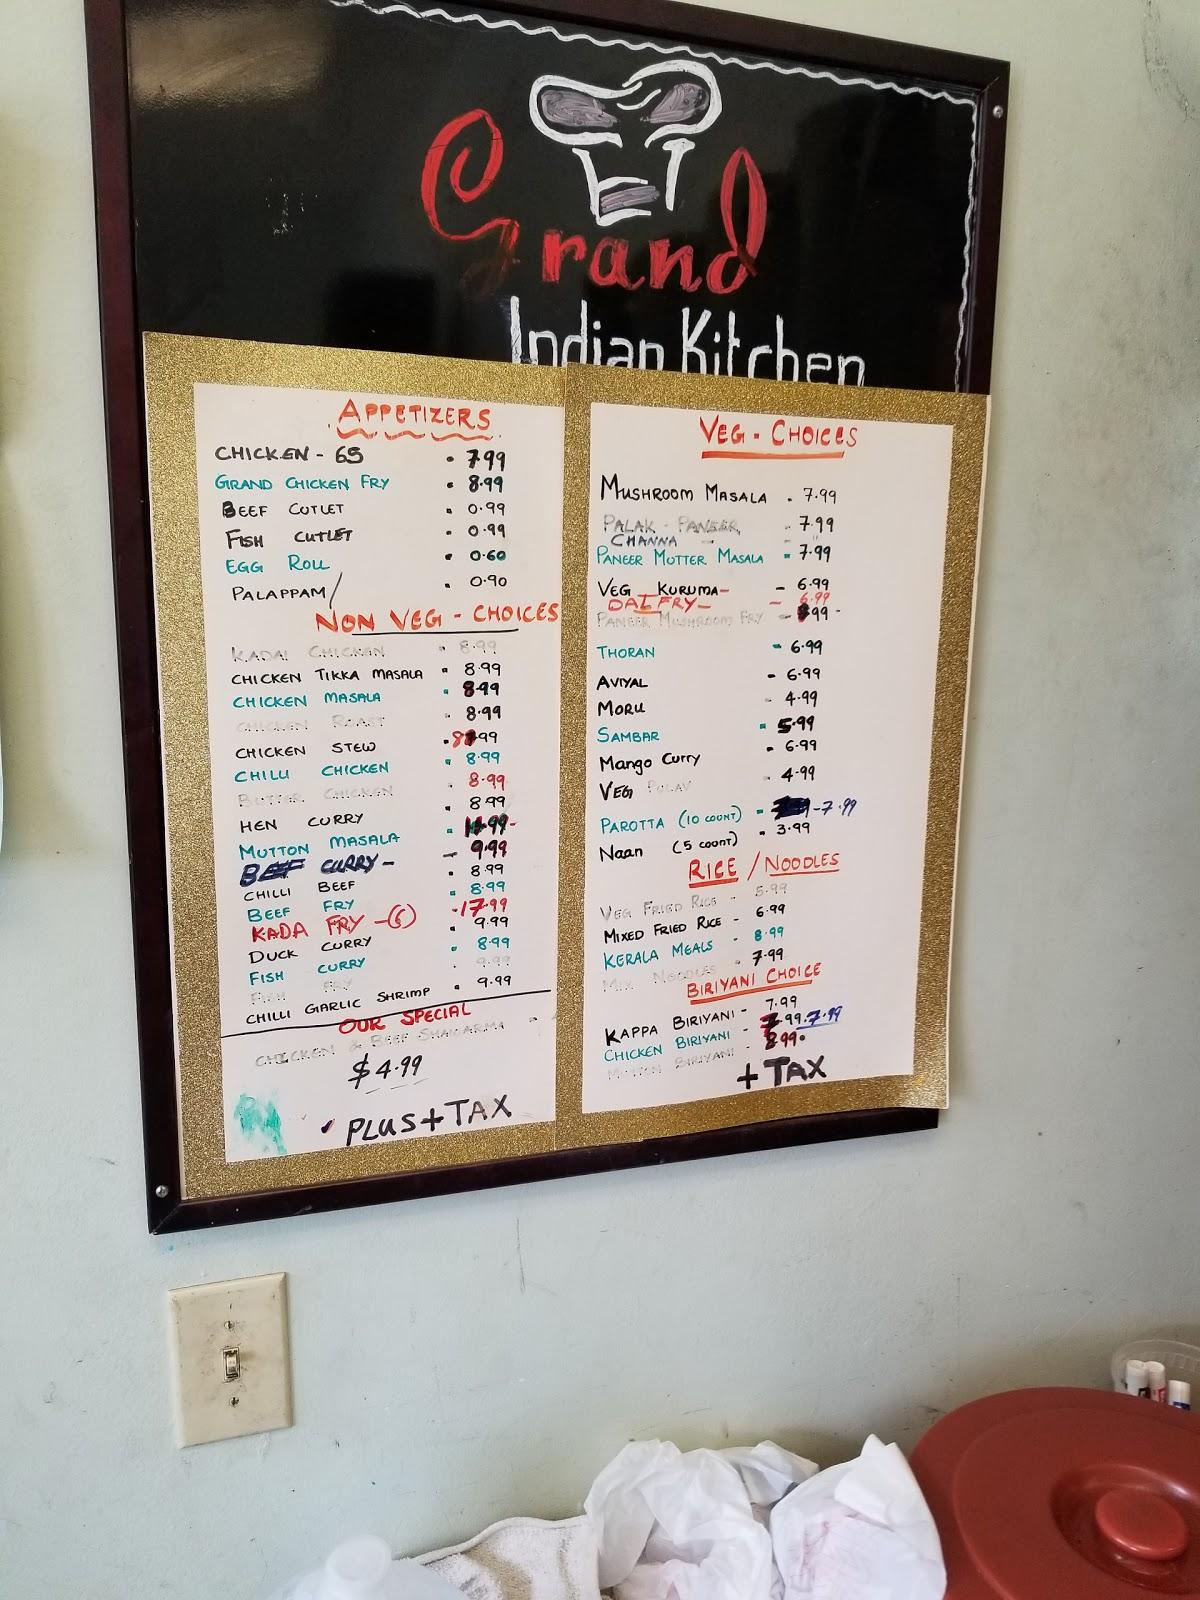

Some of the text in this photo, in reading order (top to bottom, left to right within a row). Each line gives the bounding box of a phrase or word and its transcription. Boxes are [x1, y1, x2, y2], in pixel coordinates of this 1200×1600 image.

[421, 108, 767, 295] Grand
[510, 296, 865, 387] Indian Kitchen
[338, 398, 491, 431] APPETIZERS
[700, 415, 745, 445] VEG
[215, 446, 308, 461] CHICKEN
[335, 446, 364, 463] 65
[215, 474, 504, 493] GRAND CHICKEN FRY 8.99
[601, 473, 837, 504] MUSHROOM MASALA 7.99
[223, 501, 505, 518] BEEF CUTLET 0.99
[225, 523, 506, 549] FISH CUTLET 0.99
[799, 515, 834, 533] 7.99
[226, 549, 506, 574] EGG ROLL 0.60
[596, 545, 643, 566] PANEER
[718, 547, 764, 564] MASALA
[799, 544, 831, 563] 7.99
[469, 574, 507, 587] 0.90
[597, 577, 631, 597] VEG
[797, 578, 829, 592] 6.99
[315, 602, 559, 633] NON VEG CHOICES
[597, 639, 823, 659] THORAN 6.99
[231, 662, 501, 686] CHICKEN TIKKA MASALA 8.99
[597, 667, 821, 690] AVIYAL 6.99
[233, 695, 307, 709] CHICKEN
[325, 692, 381, 703] MASALA
[466, 705, 502, 721] 8.99
[598, 690, 818, 716] MORU 4.99
[597, 715, 815, 743] SAMBAR 5.99
[235, 742, 376, 760] CHICKEN STEW
[322, 762, 389, 776] CHICKEN
[466, 752, 501, 767] 8.99
[600, 739, 817, 776] Mango Curry 6.99
[469, 772, 505, 791] 8.99
[600, 781, 634, 800] VEG
[781, 766, 815, 781] 4.99
[241, 819, 278, 833] HEN
[307, 813, 364, 828] CURRY
[601, 816, 664, 834] PAROTTA
[239, 833, 400, 860] MUTTON MASALA
[600, 844, 643, 862] Naan
[777, 823, 810, 835] 3.99
[689, 857, 737, 880] RICE
[244, 863, 504, 902] CHILLI BEEF 8.99
[248, 881, 506, 923] BEEF FRY 8.99
[325, 914, 365, 936] FRY
[604, 904, 786, 944] MIXED FRIED RICE 6.99
[249, 916, 509, 964] DUCK CURRY 9.99
[604, 926, 784, 970] KERALA MEALS 8.99
[249, 936, 510, 986] FISH CURRY 8.99
[752, 947, 784, 967] 7.99
[687, 962, 822, 999] BIRIYANI CHOICE
[246, 1010, 291, 1025] CHILLI
[304, 998, 362, 1015] GARLIC
[376, 986, 431, 1003] SHRIMP
[477, 975, 511, 988] 9.99
[339, 1002, 471, 1035] OUR SPECIAL
[605, 1025, 658, 1046] KAPPA
[766, 996, 797, 1010] 7.99
[605, 1044, 663, 1062] CHICKEN
[675, 1030, 730, 1050] BIRIYANI
